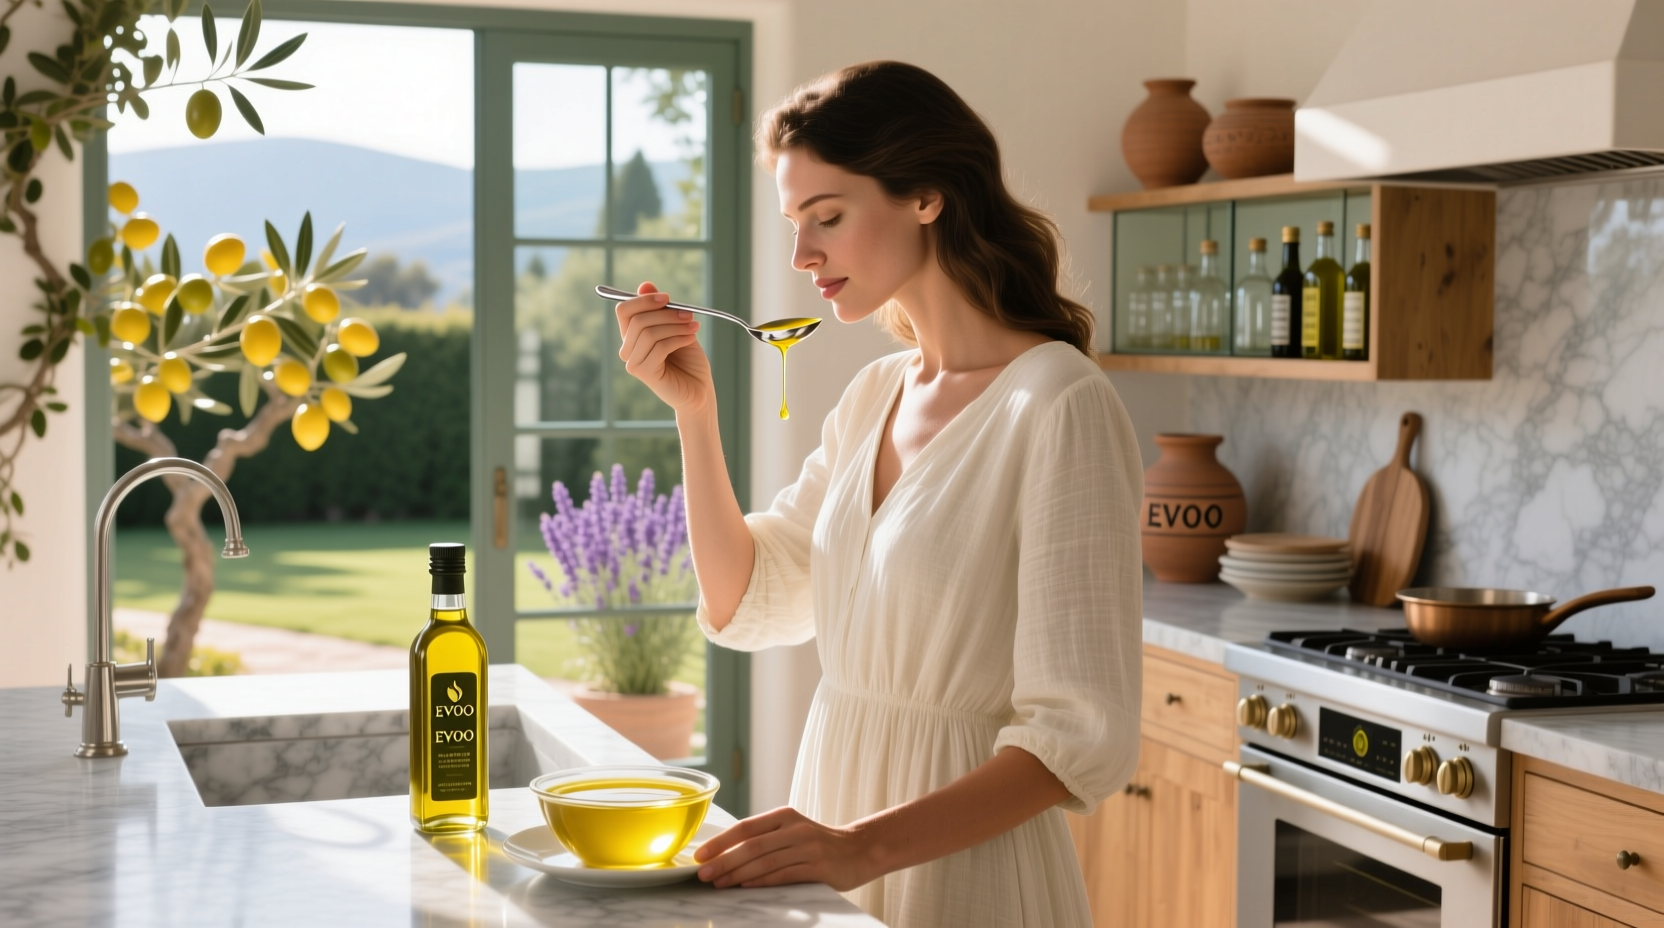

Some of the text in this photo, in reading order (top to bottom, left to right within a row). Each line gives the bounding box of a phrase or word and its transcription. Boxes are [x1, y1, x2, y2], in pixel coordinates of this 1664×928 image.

[1148, 502, 1223, 529] EVOO
[435, 704, 474, 718] EVOO
[435, 729, 474, 743] EVOO
